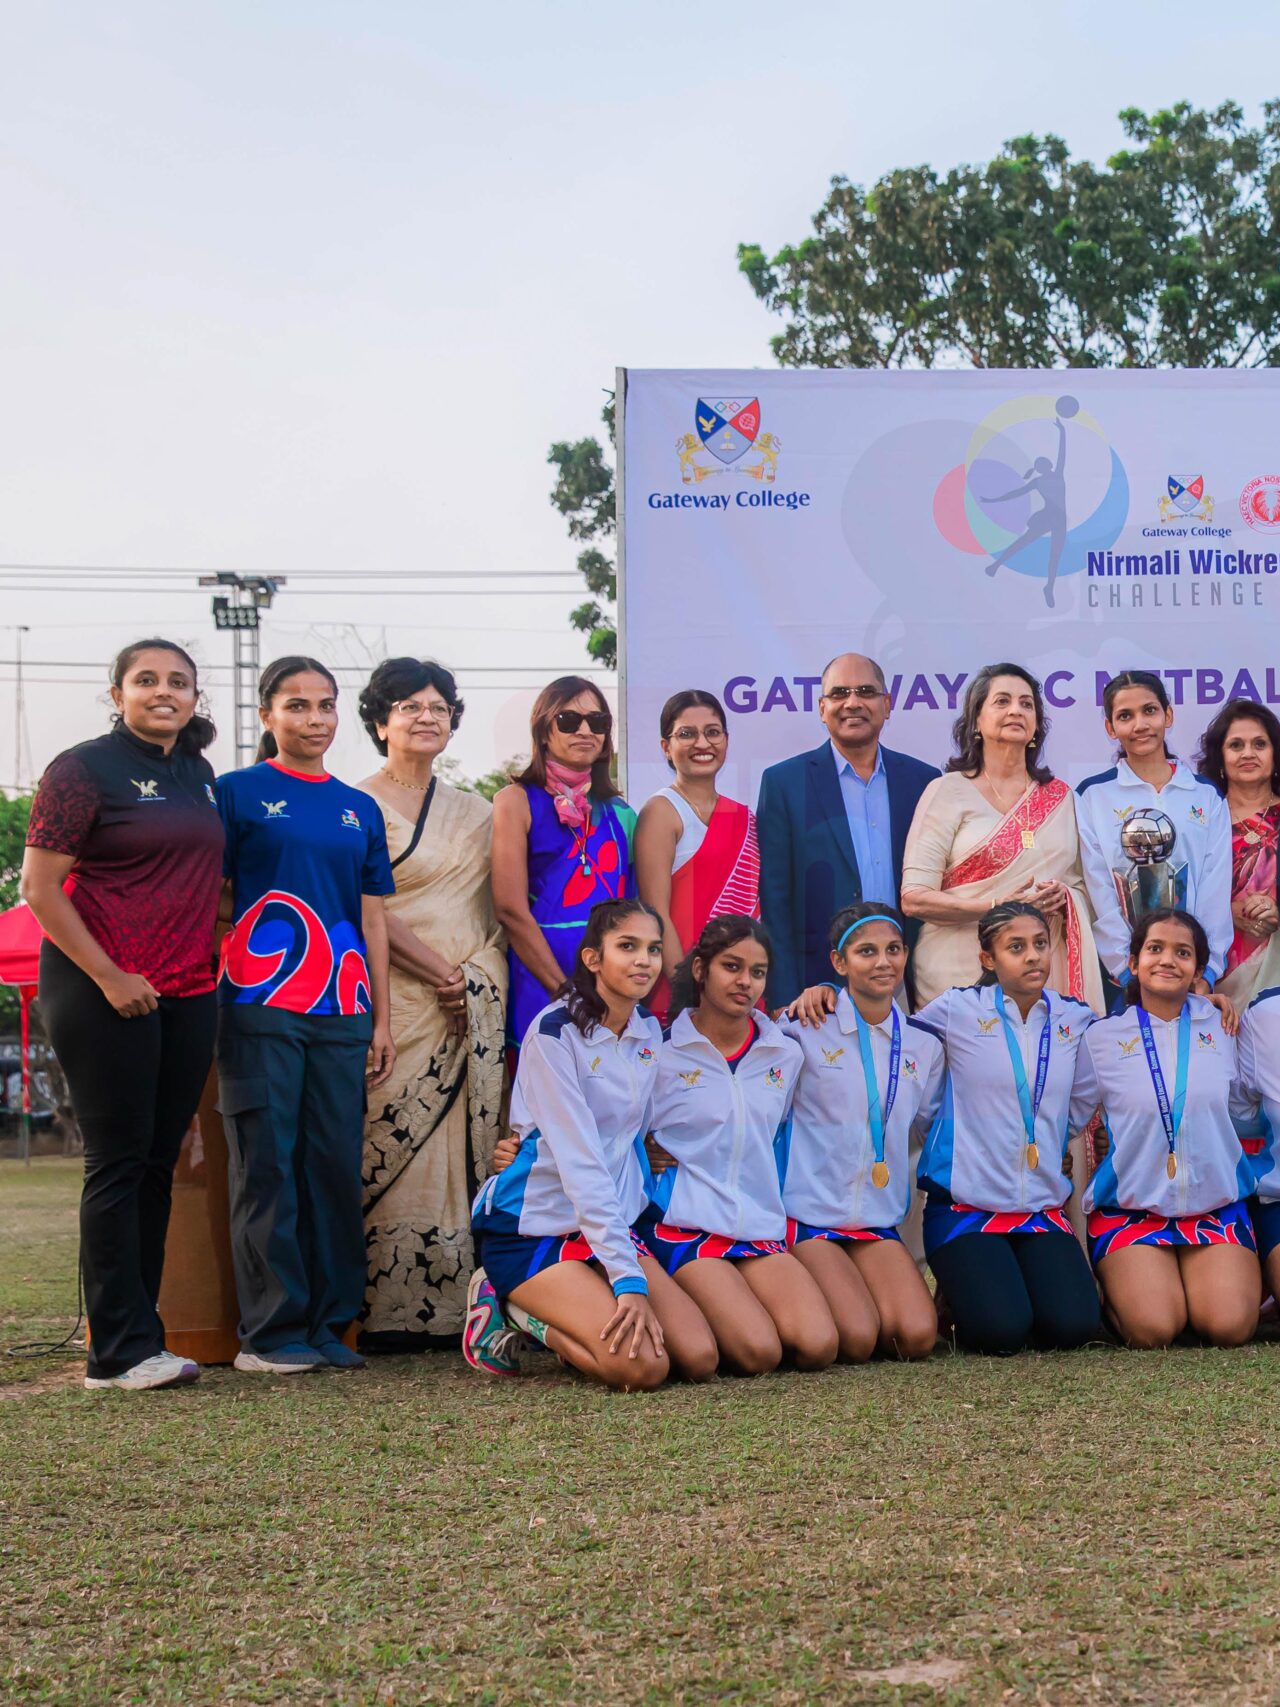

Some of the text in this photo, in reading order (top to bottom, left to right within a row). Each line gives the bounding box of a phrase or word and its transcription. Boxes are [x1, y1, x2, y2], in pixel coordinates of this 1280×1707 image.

[648, 490, 810, 511] Gateway College
[1142, 526, 1232, 538] Gateway College
[1087, 550, 1180, 576] Nirmali
[1088, 582, 1263, 608] CHALLENGE
[723, 672, 968, 713] GATAY
